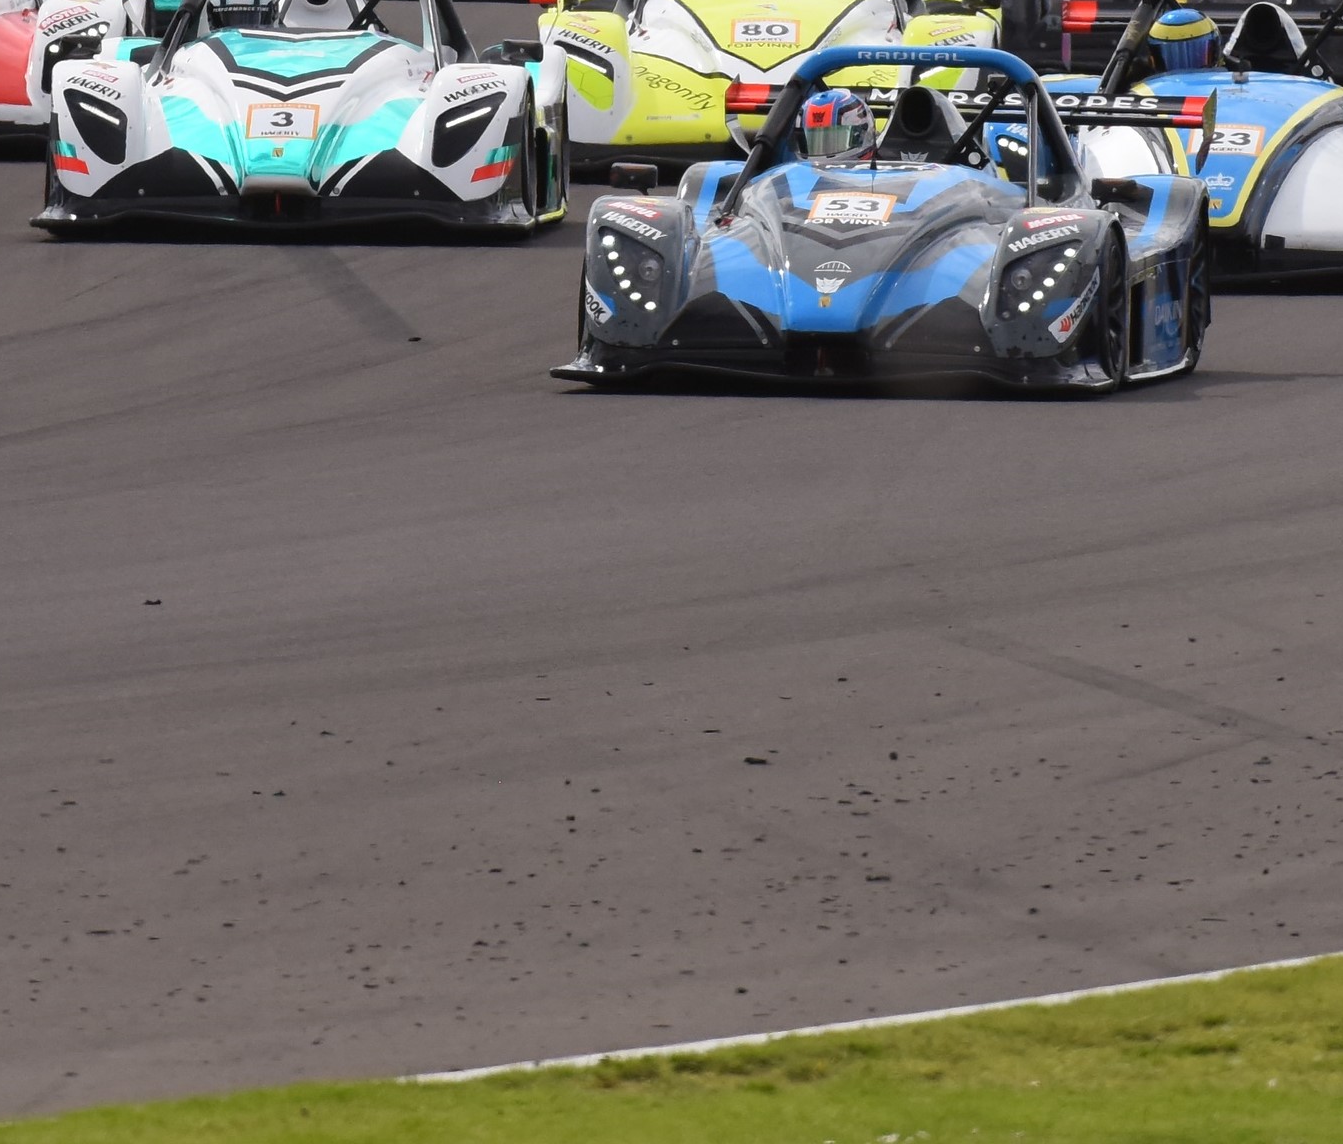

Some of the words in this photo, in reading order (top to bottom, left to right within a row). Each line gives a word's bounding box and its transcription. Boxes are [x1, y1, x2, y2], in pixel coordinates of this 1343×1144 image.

[42, 11, 101, 37] HAGERTY
[741, 24, 789, 36] 80
[558, 29, 616, 54] HAGERTY
[858, 51, 967, 62] RADICAL
[67, 75, 125, 100] HAGERTY
[444, 79, 508, 103] HAGERTY
[634, 66, 717, 110] Dragonfly
[869, 89, 1159, 110] MROSOPES
[270, 111, 295, 127] 3
[1211, 131, 1251, 146] 23
[607, 201, 659, 219] MOTUL
[825, 199, 880, 212] 53
[602, 211, 668, 240] HAGERTY
[837, 218, 892, 227] VINNY
[1026, 214, 1083, 230] MOTUL
[1008, 224, 1080, 252] HAGERTY
